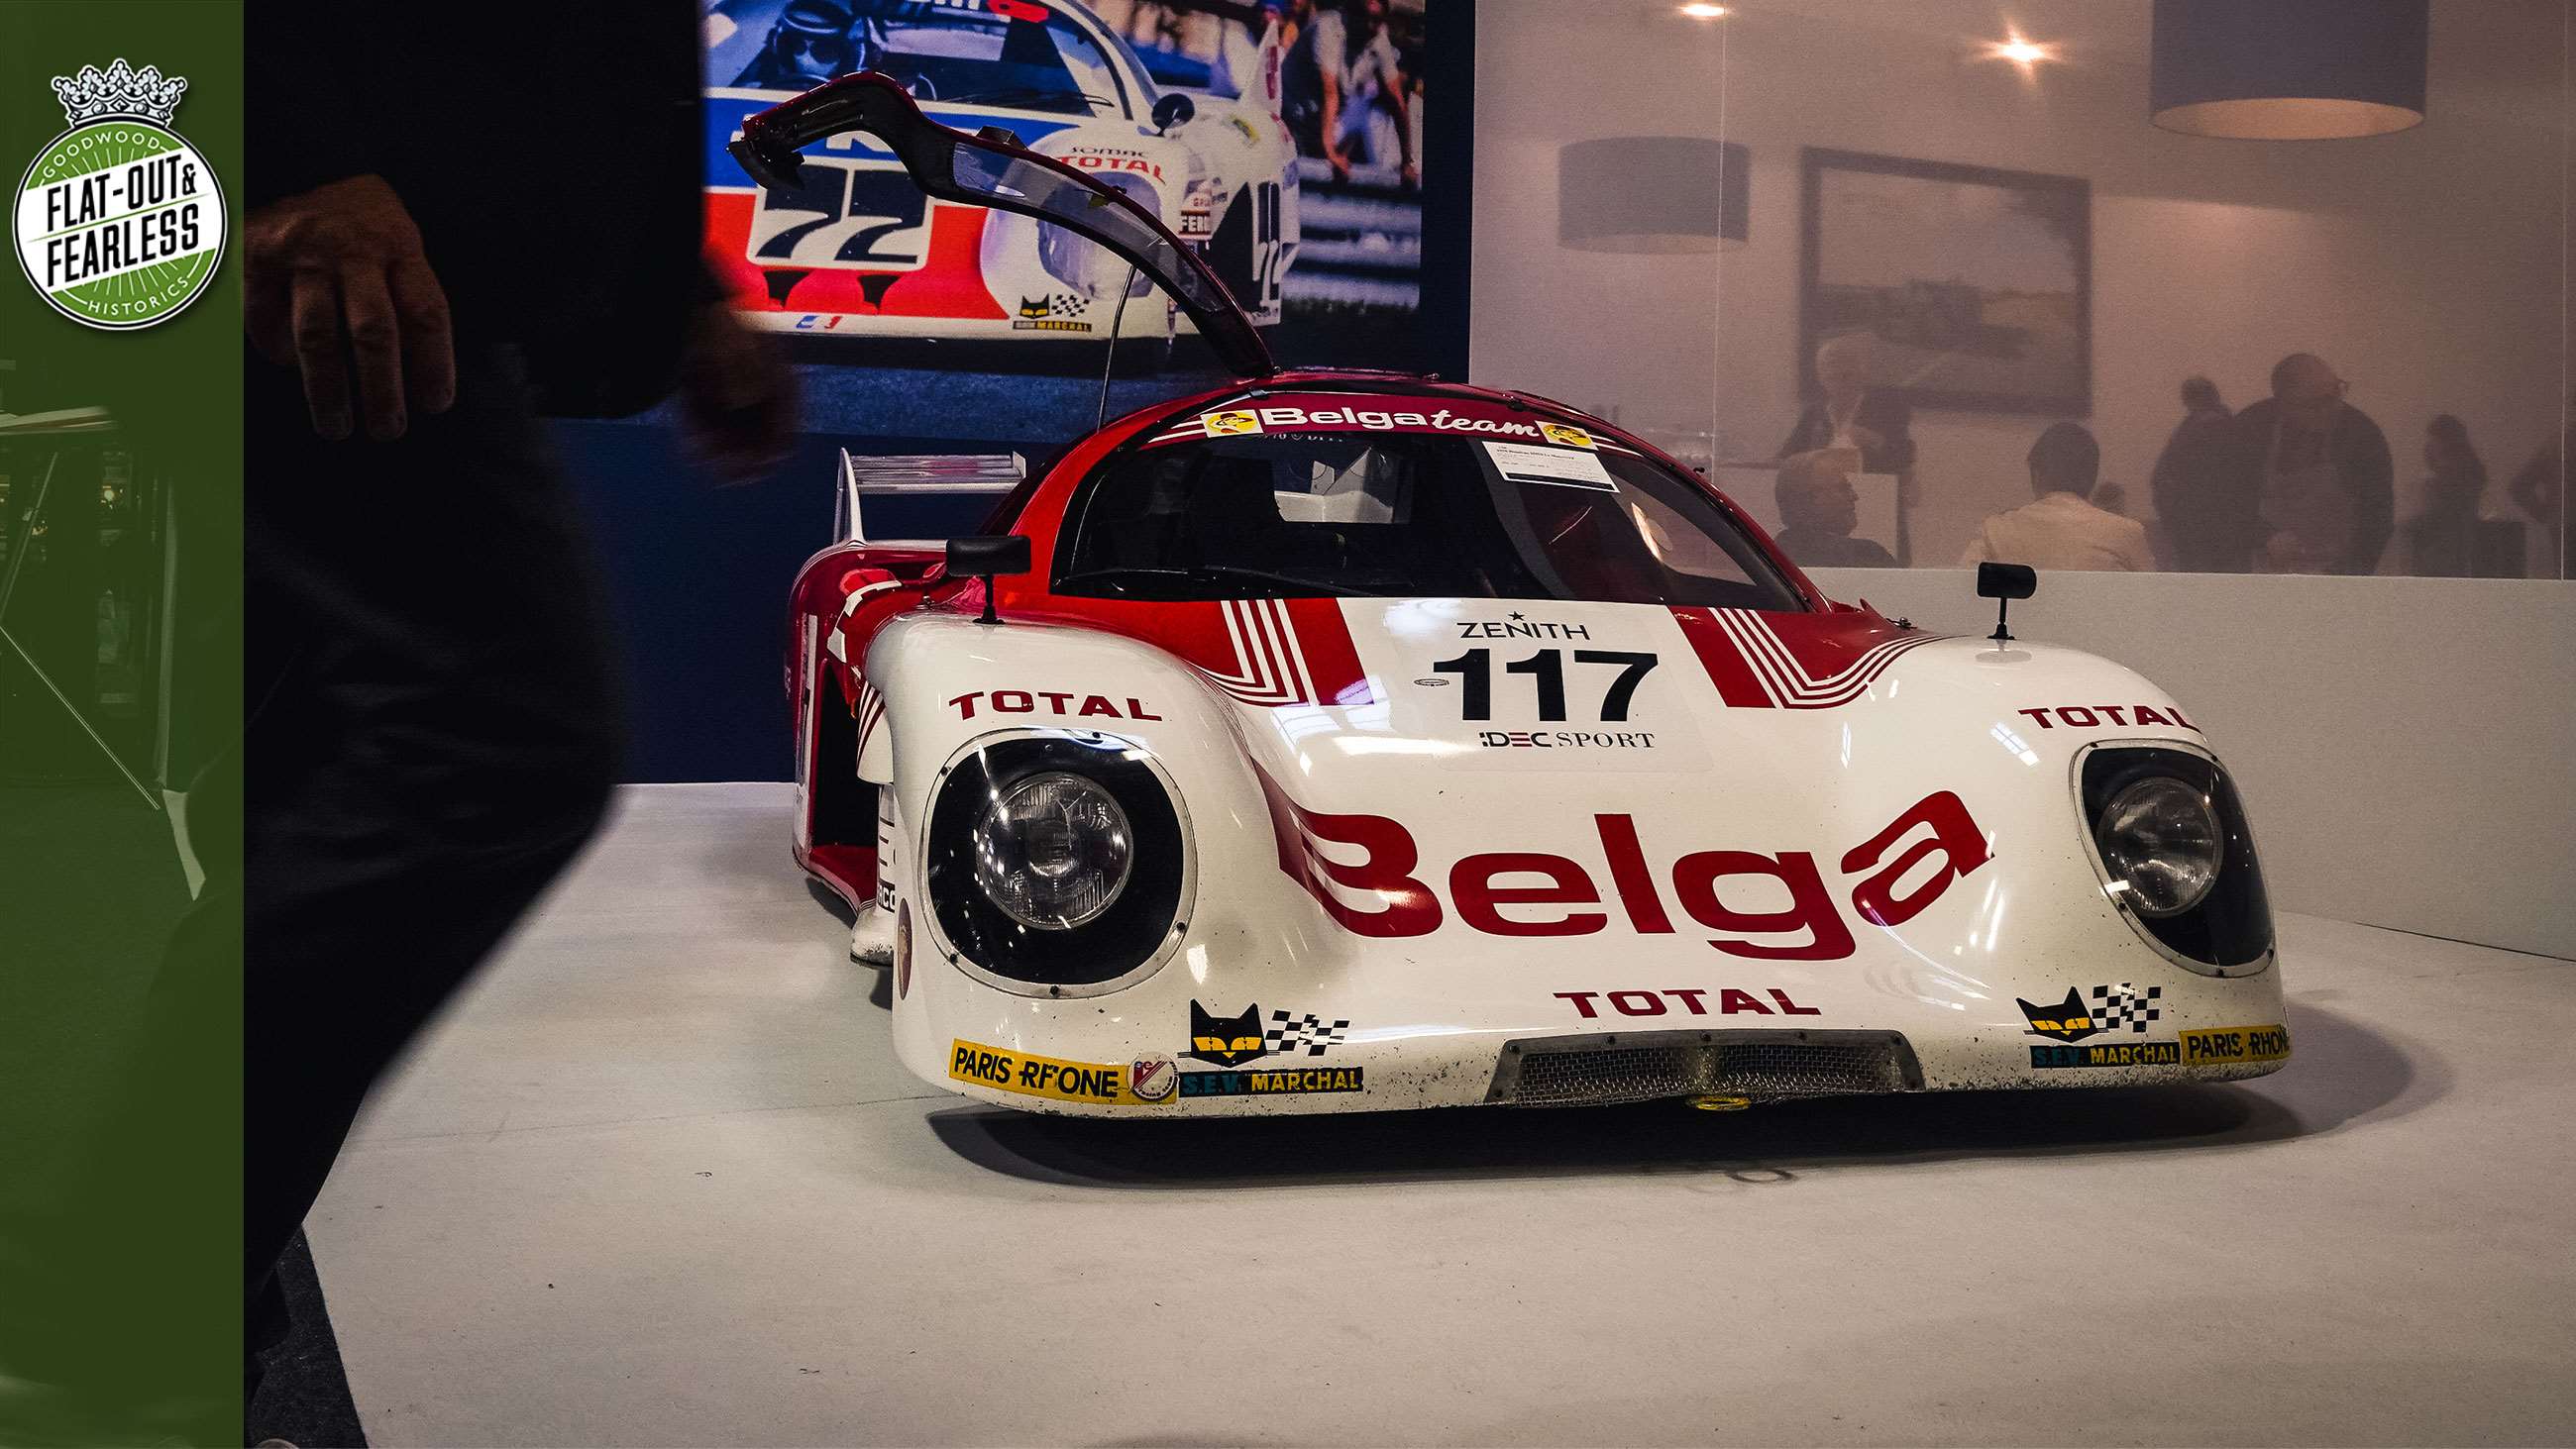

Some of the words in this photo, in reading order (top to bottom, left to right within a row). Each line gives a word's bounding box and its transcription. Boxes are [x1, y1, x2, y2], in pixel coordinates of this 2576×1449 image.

[1057, 155, 1166, 186] TOTAL
[1456, 622, 1590, 640] ZENITH
[1433, 648, 1659, 722] 117
[948, 690, 1163, 721] TOTAL
[2017, 705, 2203, 735] TOTAL
[1556, 732, 1656, 749] SPORT
[1248, 756, 1995, 961] Belga
[1553, 988, 1822, 1018] TOTAL
[2090, 1046, 2177, 1064] MARCHAL
[2188, 1032, 2243, 1059] PARIS
[954, 1047, 1013, 1084] PARIS
[1251, 1071, 1359, 1091] MARCHAL
